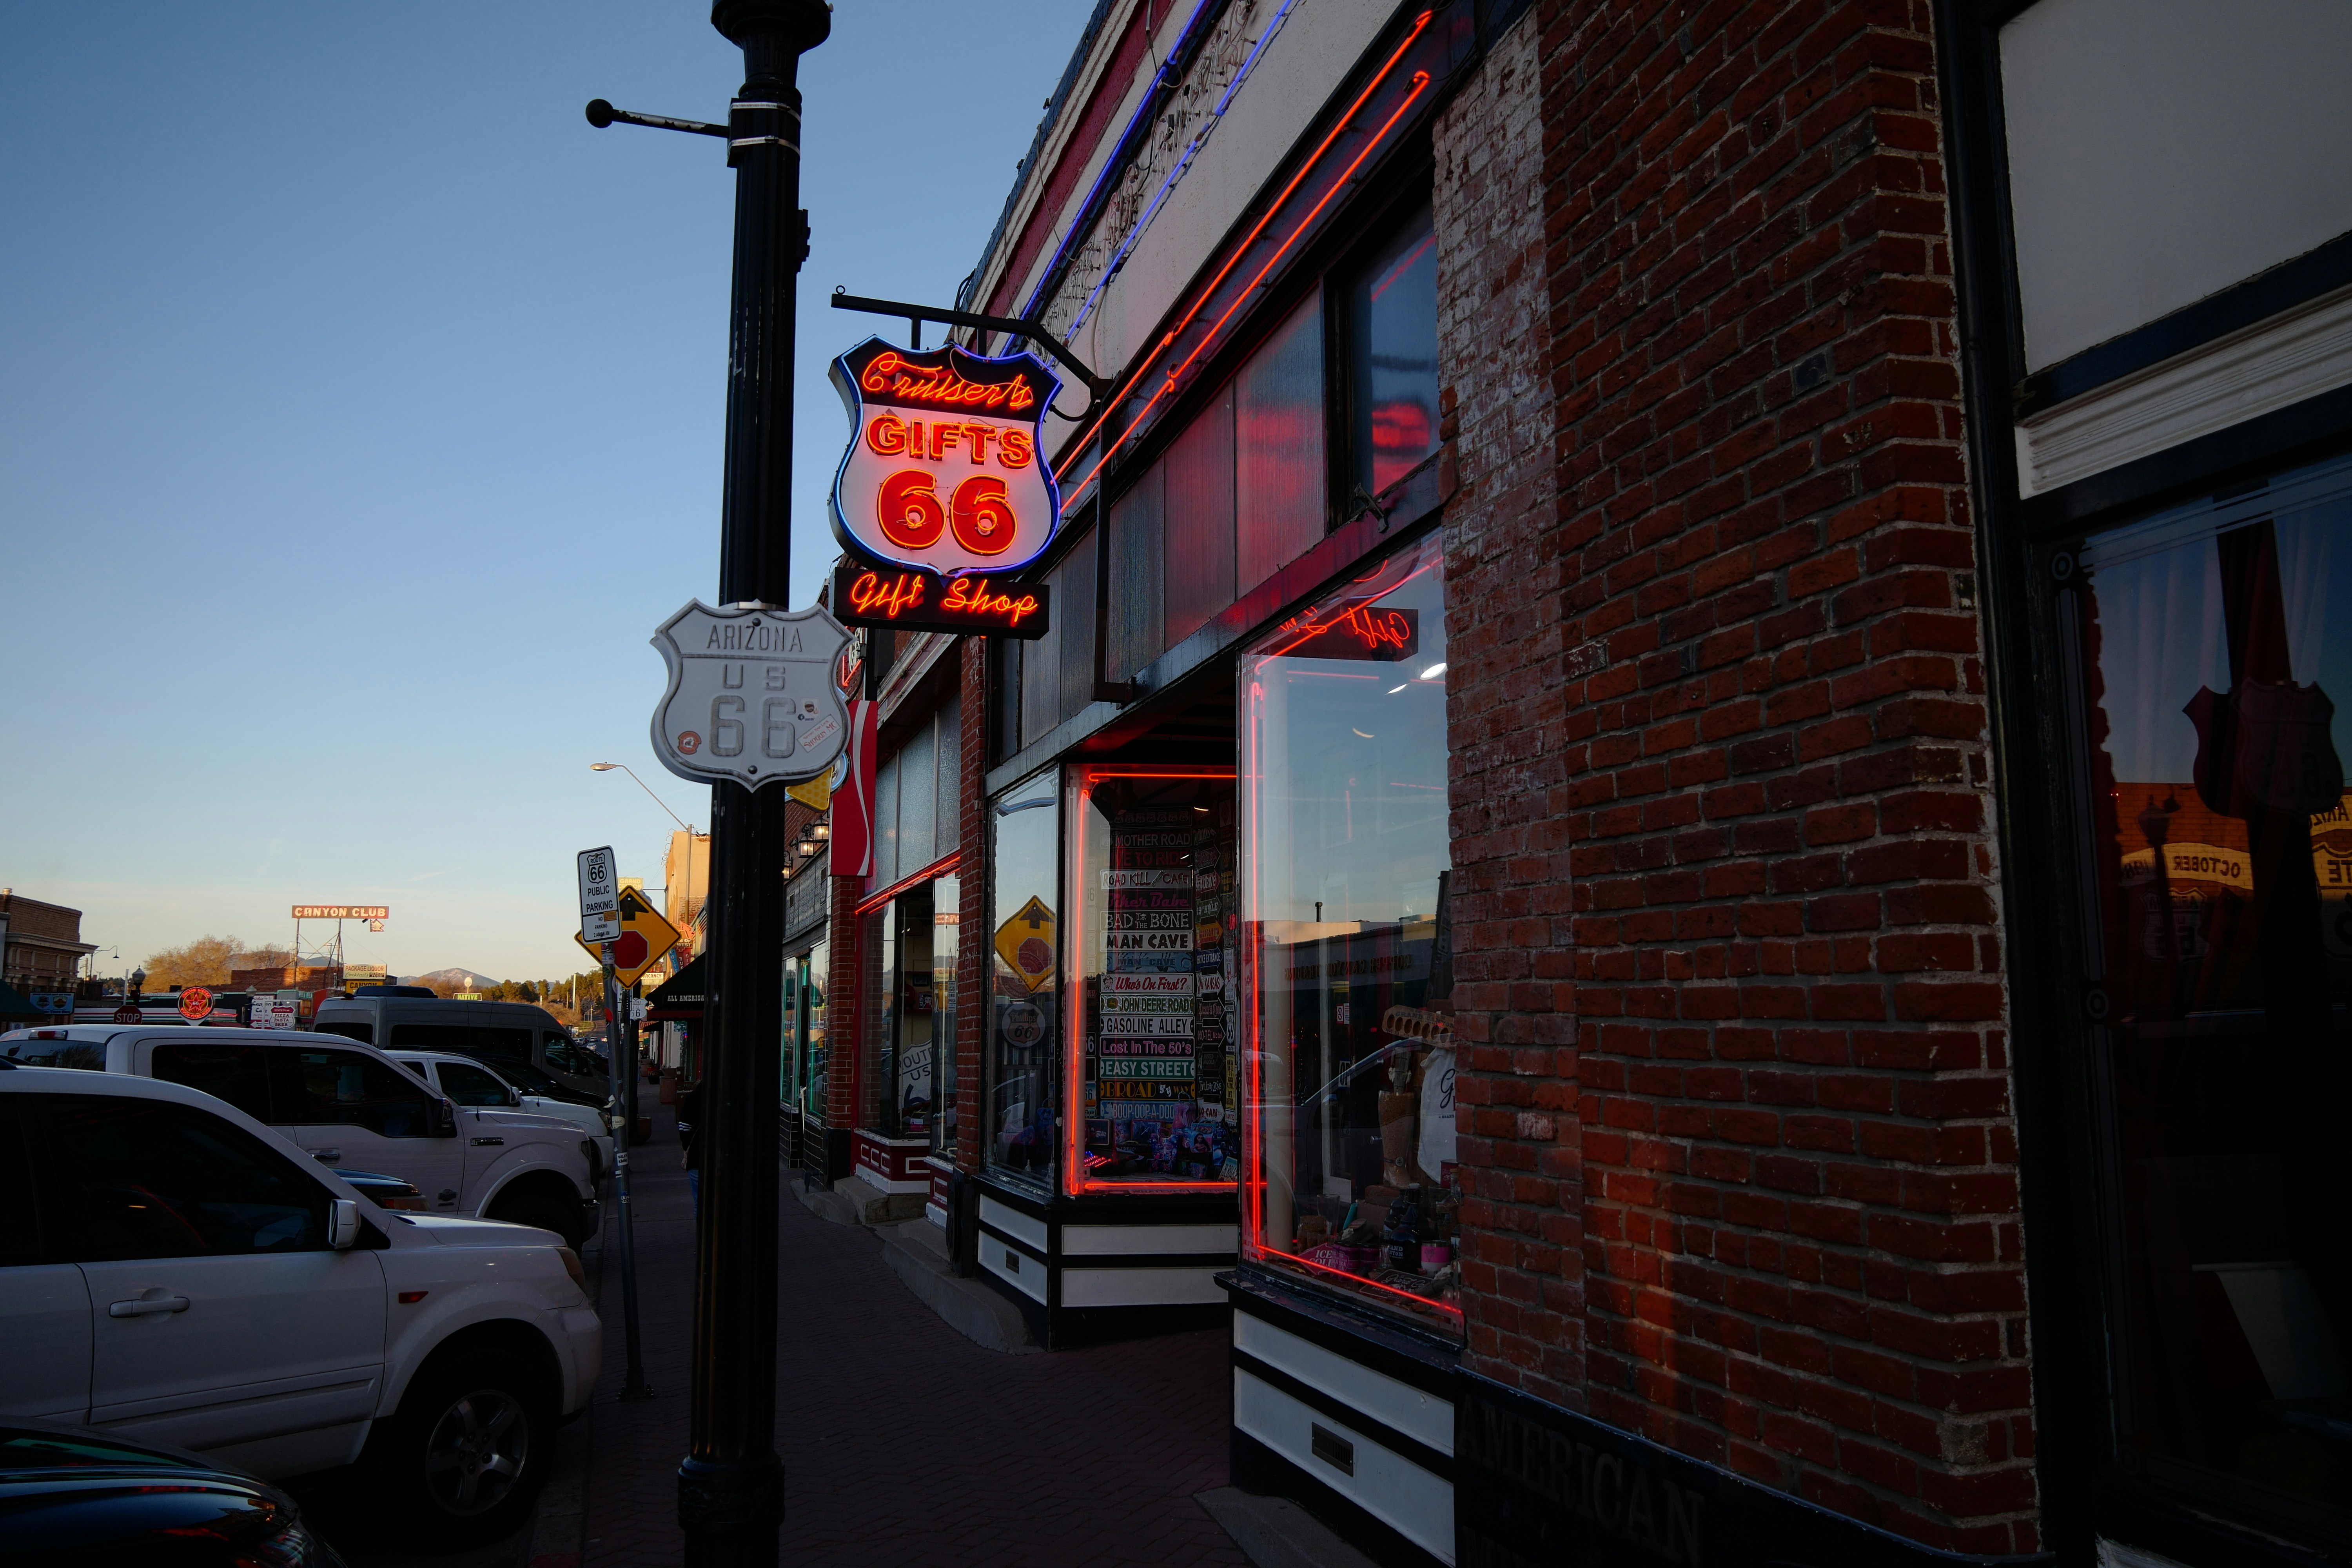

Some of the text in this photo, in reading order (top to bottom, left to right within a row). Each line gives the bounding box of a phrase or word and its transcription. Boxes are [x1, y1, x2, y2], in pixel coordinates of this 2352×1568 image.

[866, 413, 1034, 470] GIFTS
[877, 468, 1018, 556] 66
[850, 571, 1039, 623] Gift Shop
[707, 624, 803, 652] ARIZONA
[709, 695, 796, 759] 66
[826, 721, 838, 733] MC
[1115, 833, 1191, 847] MOTHER ROAD
[1135, 851, 1153, 866] TO
[1156, 851, 1189, 866] RIDE
[590, 865, 605, 881] 66
[1103, 871, 1189, 887] ROAD KILL CAFE
[1203, 875, 1216, 889] DRIVE
[588, 885, 610, 897] PUBLIC
[586, 900, 613, 913] PARKING
[1149, 892, 1189, 908] Babe
[295, 907, 386, 917] CANYON CLUB
[1104, 913, 1133, 928] BAD
[1150, 912, 1189, 928] BONE
[1105, 933, 1188, 949] MAN CAVE
[1196, 955, 1206, 964] SERVICE
[1206, 952, 1221, 964] ENTRANCE
[1115, 976, 1187, 991] Who's On First?
[1204, 976, 1220, 990] KANSAS
[1120, 997, 1140, 1012] JOHN
[1141, 997, 1166, 1012] DEERE
[1168, 997, 1189, 1013] ROAD
[116, 1013, 140, 1023] STOP
[1010, 1011, 1037, 1023] Phillips
[1395, 1011, 1423, 1019] GRAND
[1014, 1025, 1034, 1038] 66
[1107, 1017, 1188, 1034] GASOLINE ALLEY
[1227, 1024, 1234, 1039] 66
[1102, 1040, 1192, 1054] Lost In The 50's
[910, 1066, 931, 1081] US
[1105, 1061, 1189, 1076] EASY STREET
[1105, 1082, 1190, 1098] BROAD WAY
[1315, 1249, 1332, 1259] ICE
